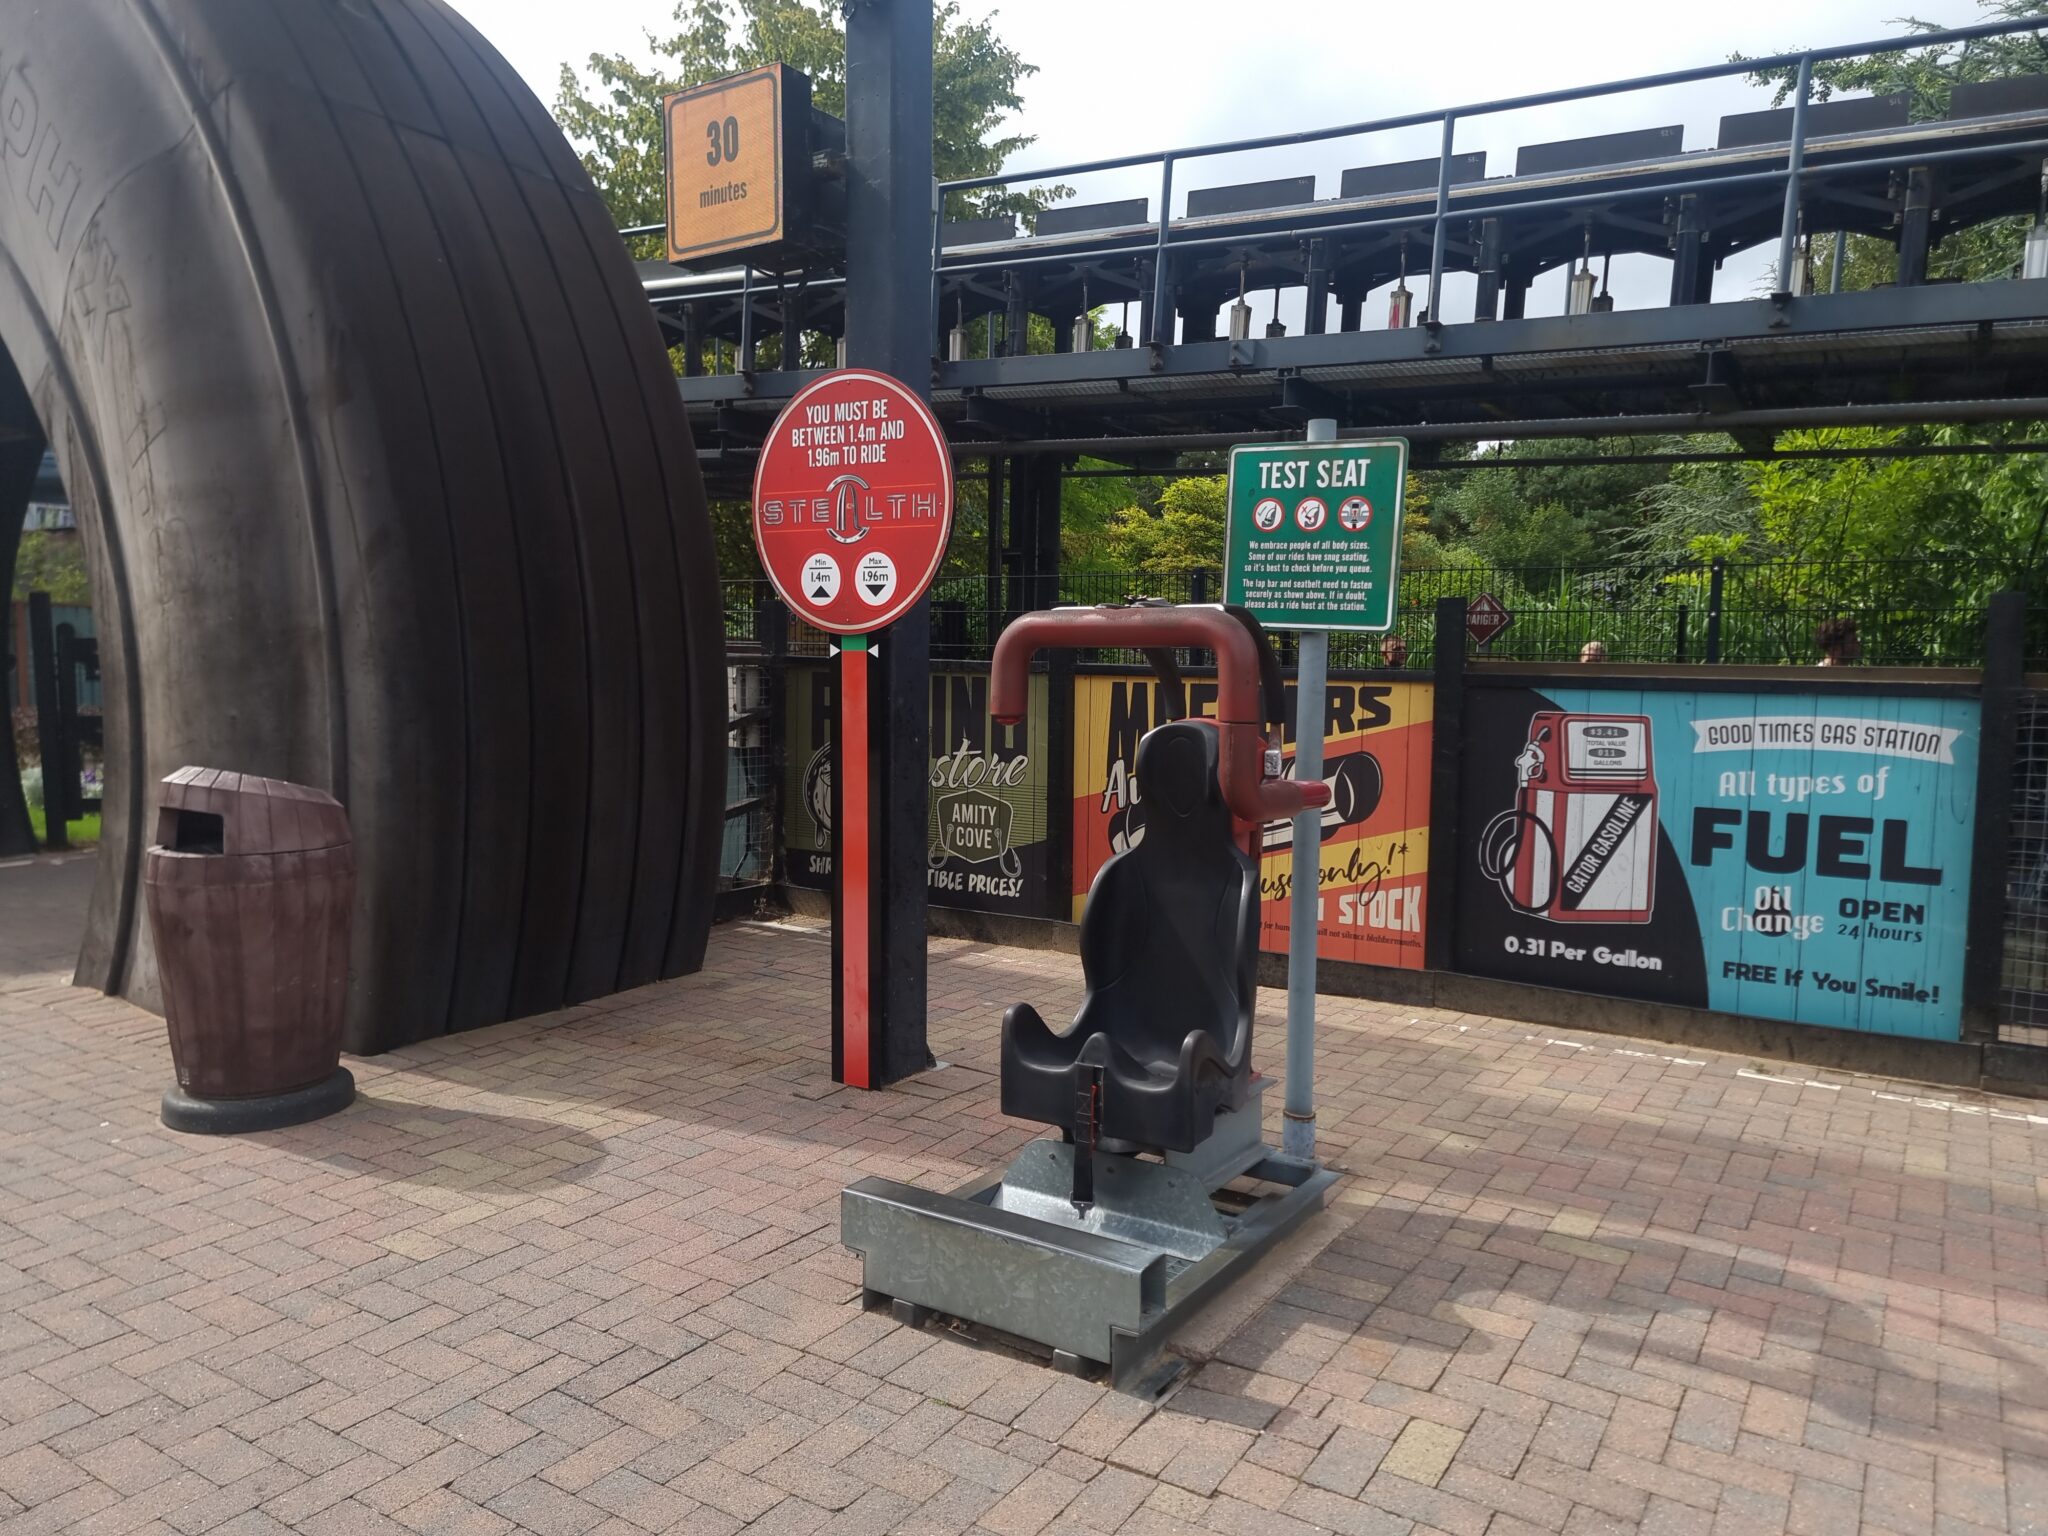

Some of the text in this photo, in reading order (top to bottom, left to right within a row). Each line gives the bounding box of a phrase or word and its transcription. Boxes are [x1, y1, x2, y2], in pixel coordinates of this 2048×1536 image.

[706, 115, 739, 167] 30
[699, 181, 747, 209] minutes
[806, 399, 888, 425] YOU MUST BE
[792, 420, 904, 447] BETWEEN 1.4m AND
[807, 443, 886, 467] 1.96m TO RIDE
[1258, 458, 1371, 489] TEST SEAT
[763, 480, 936, 533] STEALTH
[1248, 552, 1370, 563] Some of our rides have snug seating,
[1249, 540, 1370, 551] We embrace people of all body sizes.
[814, 558, 827, 566] Min
[868, 557, 882, 565] Max
[1244, 563, 1372, 575] so it's best to check before you queue.
[810, 572, 830, 583] 1.4m
[862, 571, 889, 582] 1.96m
[1242, 579, 1373, 589] The lap bar and seatbelt need to fasten
[1244, 600, 1265, 609] please
[1266, 600, 1279, 609] ask
[1286, 600, 1299, 609] ride
[1300, 601, 1316, 610] host
[1317, 601, 1325, 610] at
[1326, 601, 1338, 610] the
[1339, 602, 1367, 611] station.
[1245, 590, 1367, 601] securely as shown above. If in doubt,
[1707, 722, 1942, 755] GOOD TIMES GAS STATION
[928, 737, 1029, 788] store
[1719, 765, 1891, 803] All types of
[951, 802, 997, 827] AMITY
[956, 827, 993, 850] COVE
[1566, 796, 1641, 893] GATOR GASOLINE
[1690, 806, 1943, 886] FUEL
[968, 874, 1024, 898] PRICES!
[1754, 885, 1792, 912] Oil
[1338, 886, 1421, 933] STOCK
[1838, 897, 1925, 925] OPEN
[1329, 930, 1340, 938] not
[1721, 906, 1824, 941] Change
[1837, 922, 1923, 943] 24 hours
[1504, 935, 1662, 971] 0.31 Per Gallon
[1722, 961, 1940, 1004] FREE If You Smile!
